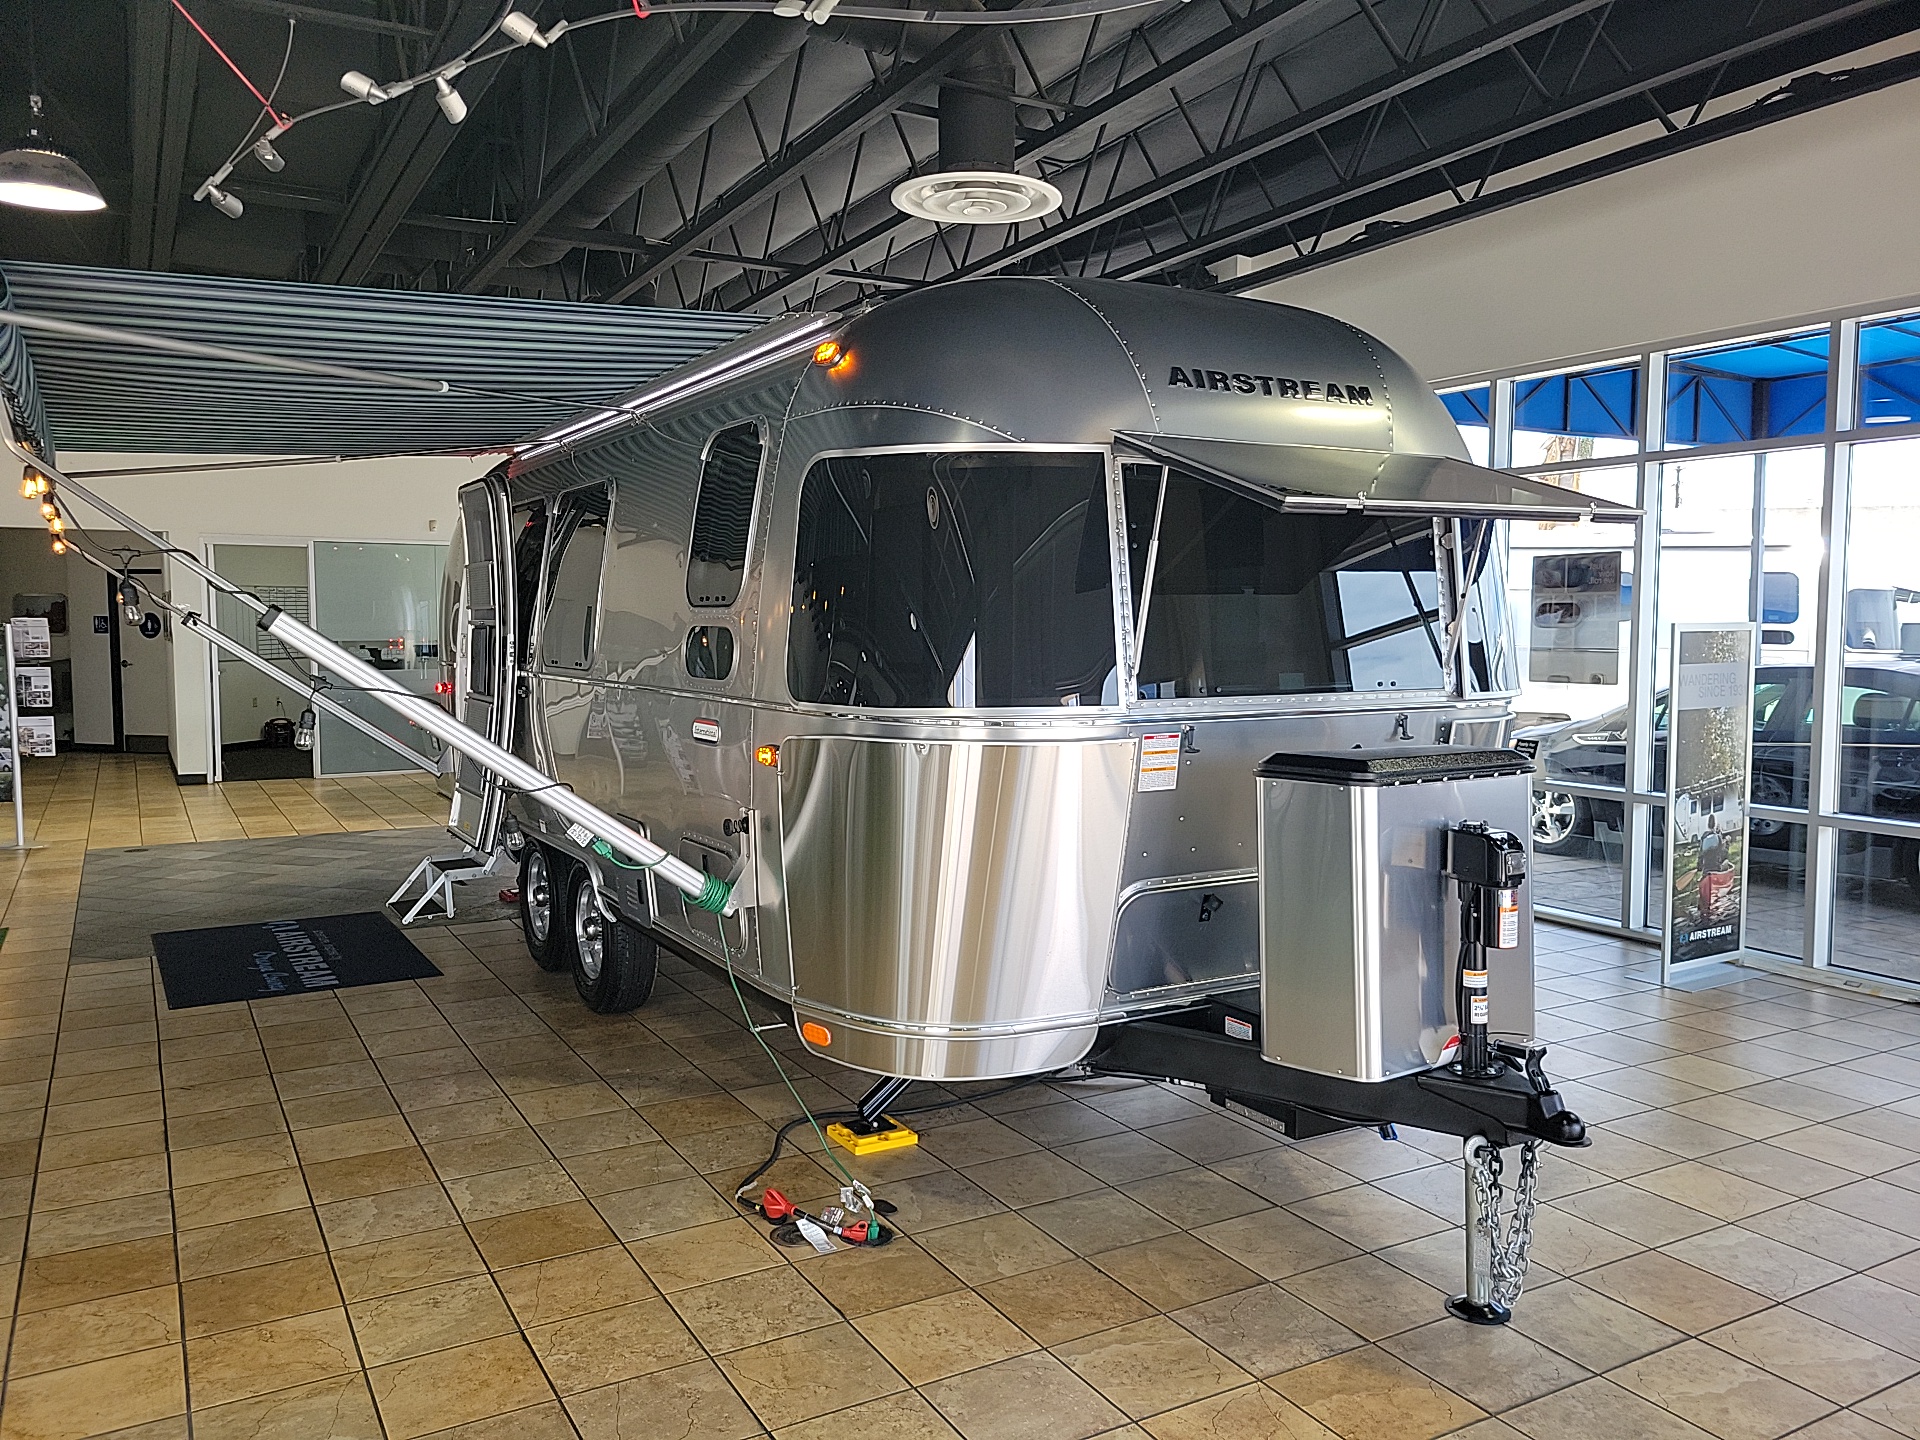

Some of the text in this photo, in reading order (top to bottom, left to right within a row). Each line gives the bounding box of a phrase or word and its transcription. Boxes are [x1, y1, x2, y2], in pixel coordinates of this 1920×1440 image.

[1168, 366, 1374, 406] AIRSTREAM
[1679, 672, 1737, 687] WANDERING
[1699, 684, 1746, 698] SINCE 193
[1689, 924, 1733, 942] AIRSTREAM
[273, 931, 340, 988] AIRSTREAM
